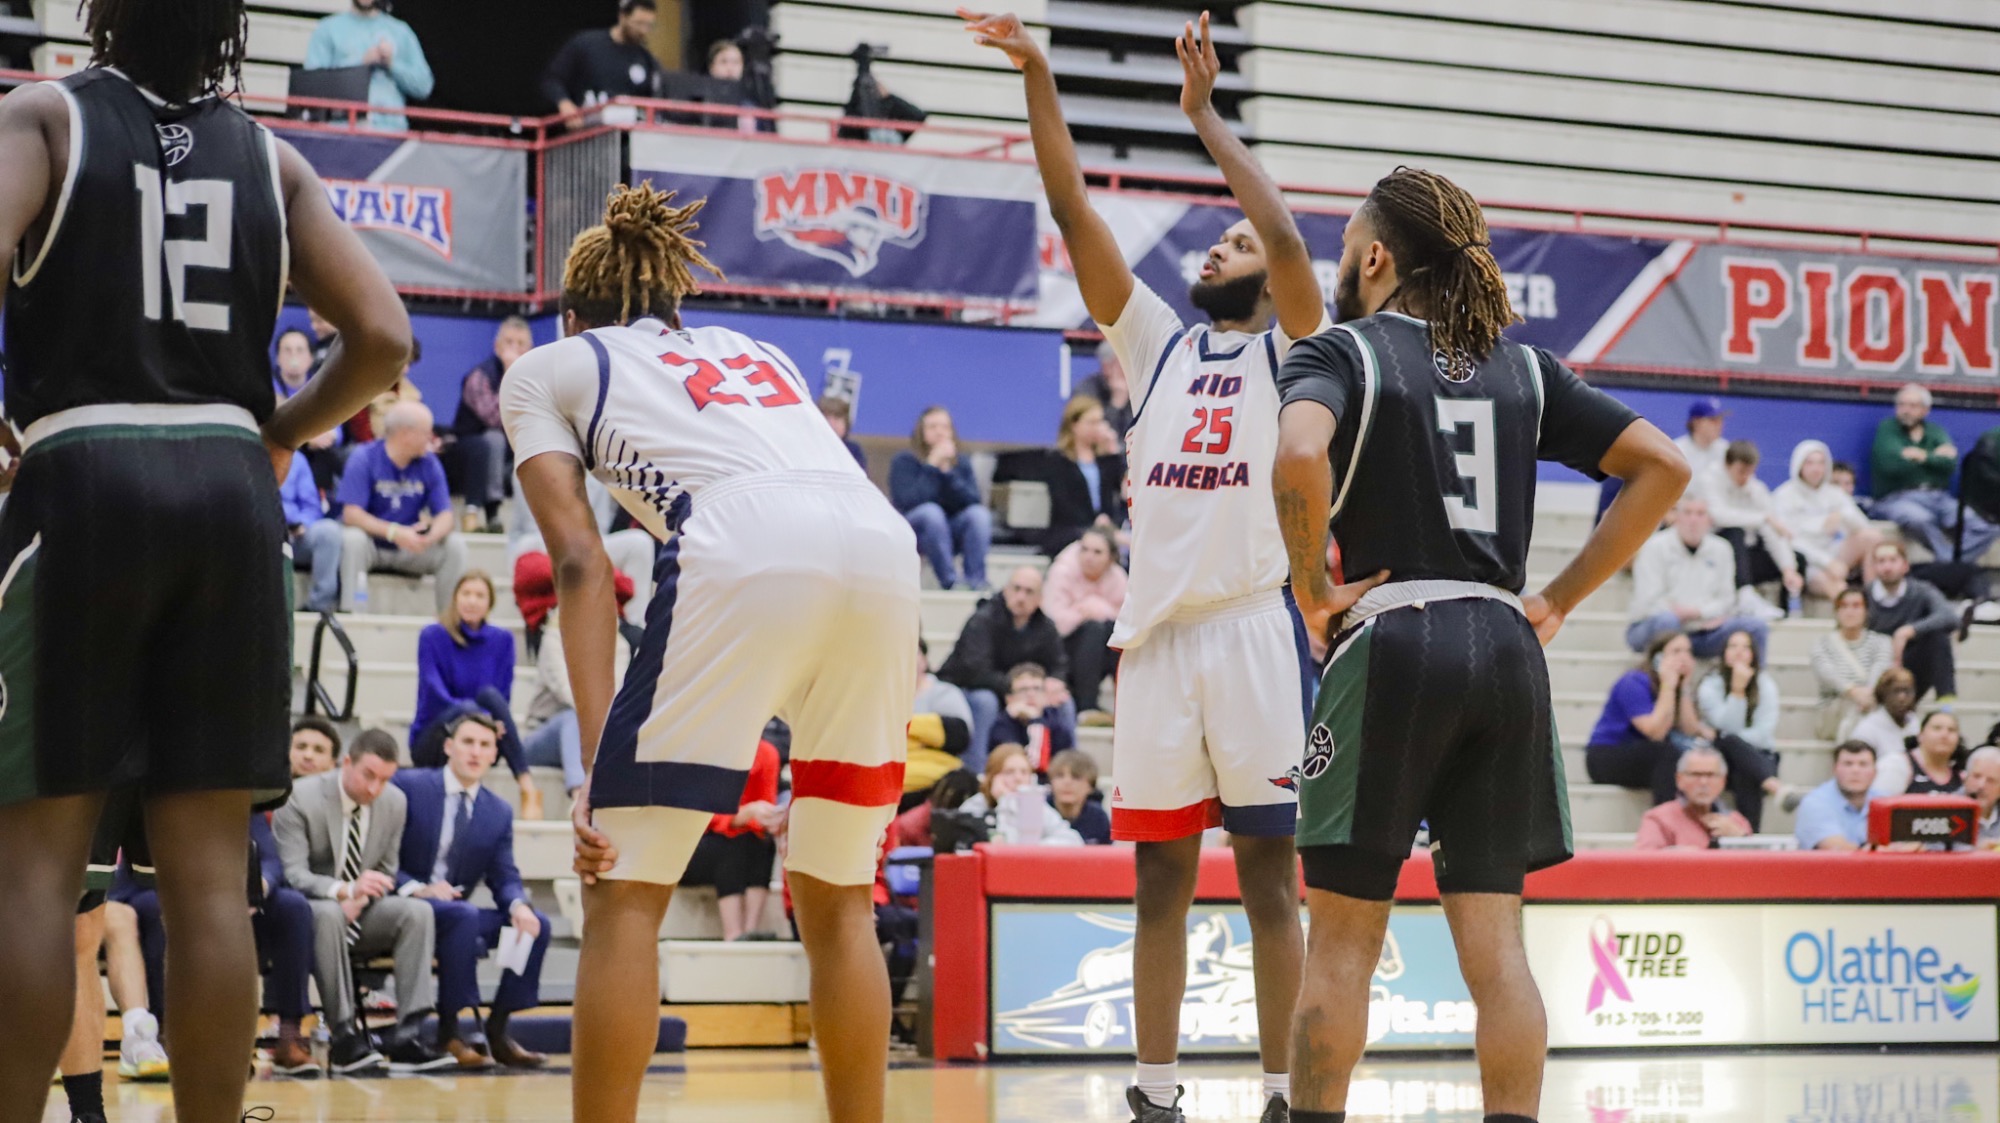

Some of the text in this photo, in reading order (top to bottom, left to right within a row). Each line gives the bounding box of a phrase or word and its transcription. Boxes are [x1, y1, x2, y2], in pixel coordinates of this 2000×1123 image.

[762, 171, 915, 231] MNU
[134, 163, 233, 333] 12
[1721, 256, 1998, 376] PION
[657, 351, 803, 412] 23
[1180, 405, 1234, 455] 25
[1434, 395, 1500, 535] 3
[1615, 932, 1685, 956] TIDD
[1625, 957, 1689, 978] TREE
[1785, 928, 1942, 985] Olathe
[1803, 987, 1939, 1023] HEALTH
